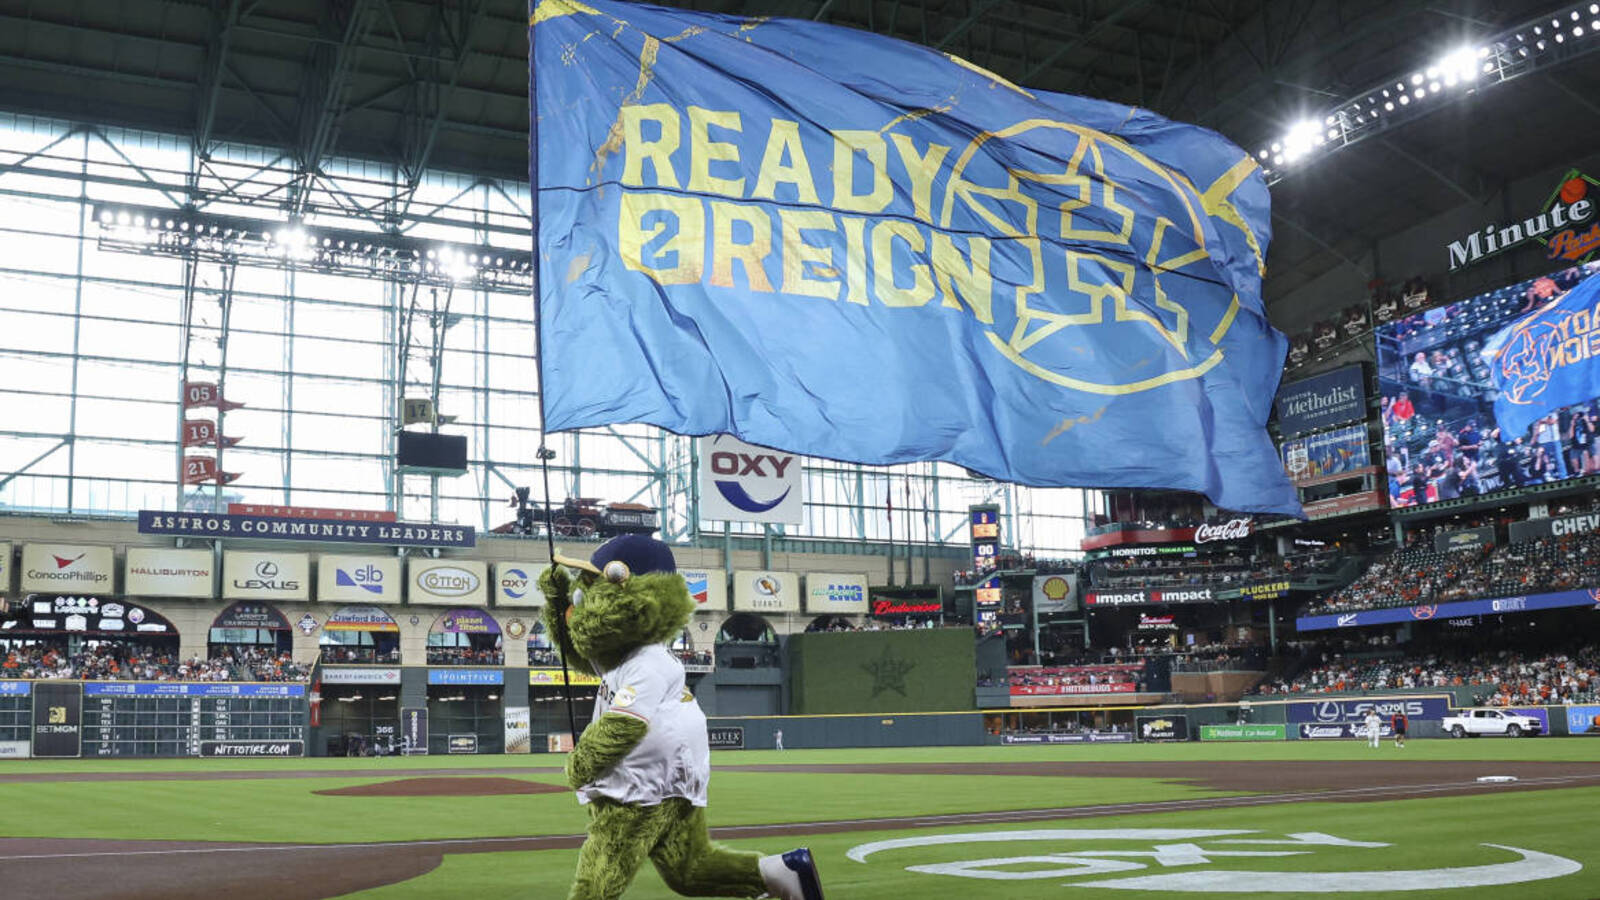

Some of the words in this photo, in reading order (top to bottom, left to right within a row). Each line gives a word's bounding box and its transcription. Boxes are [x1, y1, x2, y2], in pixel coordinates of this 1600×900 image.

[620, 102, 952, 225] READY
[1447, 199, 1593, 271] Minute
[709, 199, 994, 325] REIGN
[190, 386, 210, 401] 05
[1284, 385, 1356, 417] Methodist
[408, 404, 426, 418] 17
[190, 426, 209, 439] 19
[188, 462, 206, 475] 21
[711, 451, 793, 478] OXY
[152, 516, 231, 532] ASTROS
[241, 520, 371, 537] COMMUNITY
[379, 527, 464, 541] LEADERS
[1195, 519, 1251, 543] Coca-Cola
[1112, 547, 1157, 557] HORNITOS
[27, 569, 108, 583] ConocoPhillips
[131, 567, 209, 577] HALLIBURTON
[354, 564, 384, 583] slb
[234, 579, 299, 591] LEXUS
[424, 573, 471, 590] COTTON
[502, 579, 528, 588] OXY
[1161, 588, 1211, 603] impact
[1240, 581, 1290, 597] PLUCKERS
[1096, 592, 1146, 605] impact
[873, 600, 942, 615] Budweiser
[456, 615, 483, 625] planet
[459, 623, 488, 632] fitness
[36, 724, 78, 734] BETMGM
[214, 744, 290, 755] NITTOTIRE.COM
